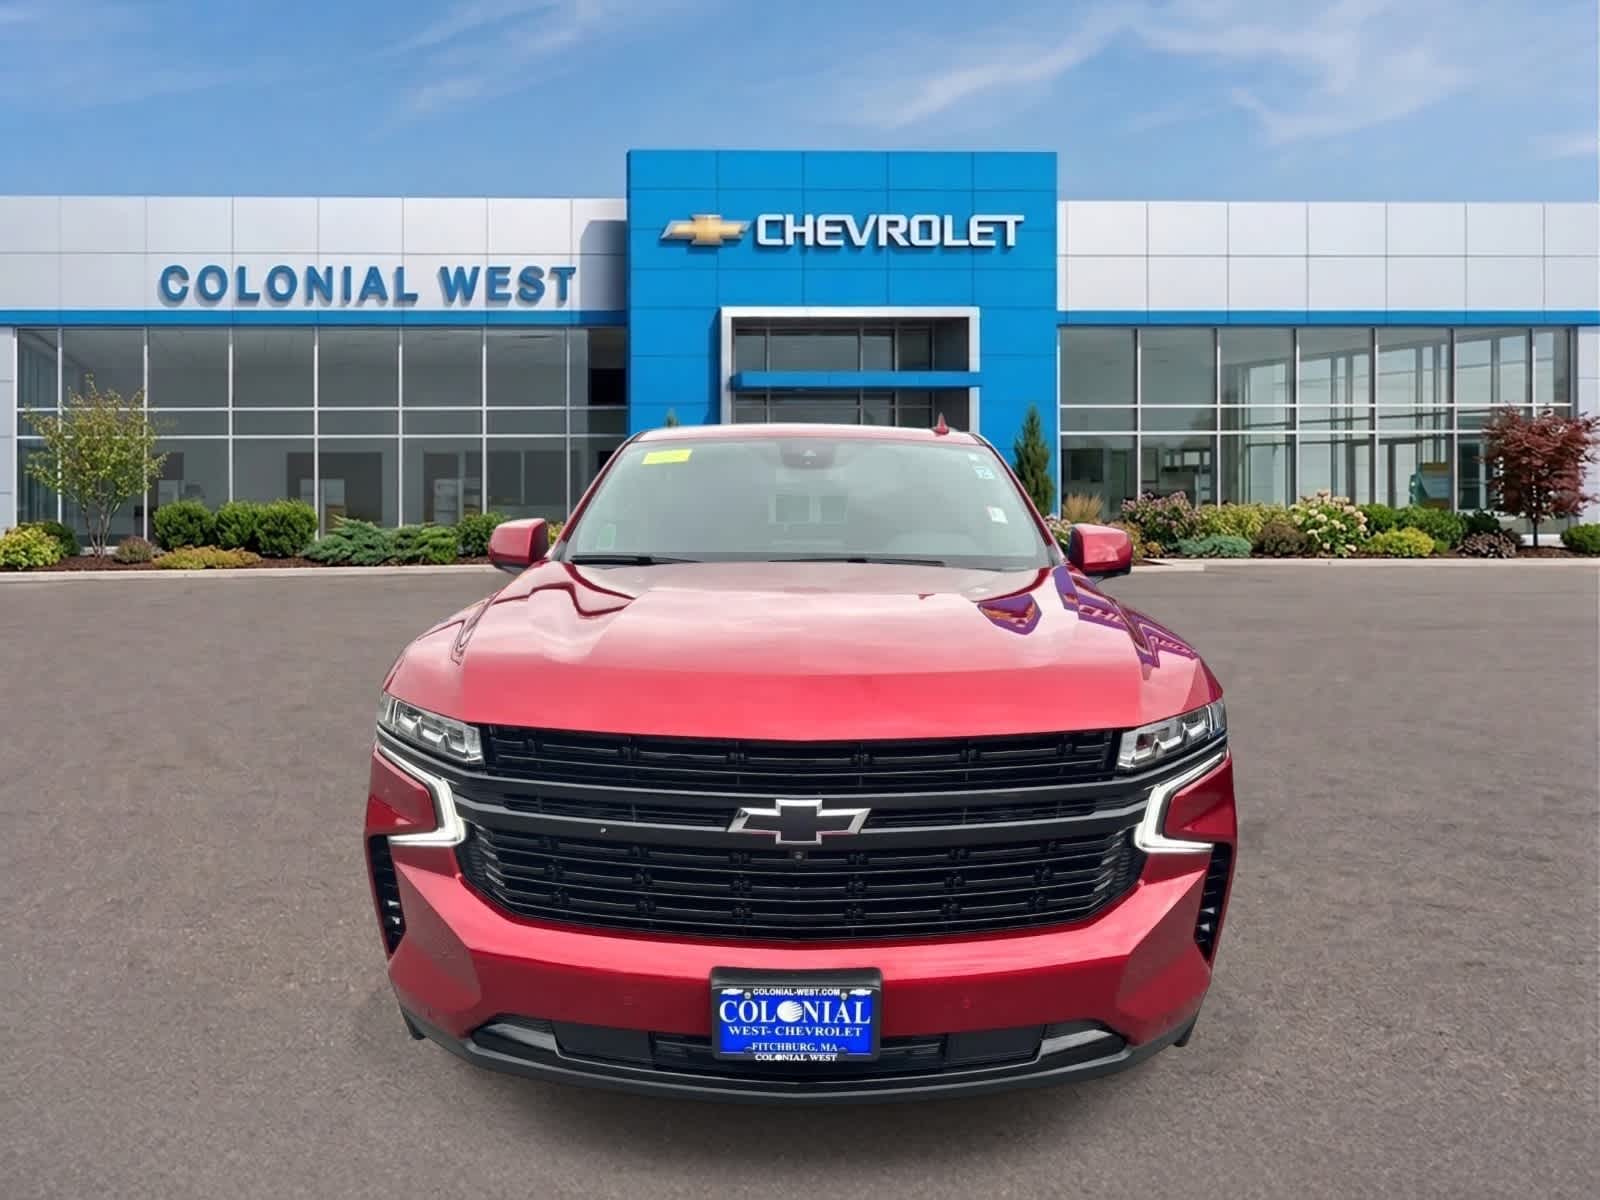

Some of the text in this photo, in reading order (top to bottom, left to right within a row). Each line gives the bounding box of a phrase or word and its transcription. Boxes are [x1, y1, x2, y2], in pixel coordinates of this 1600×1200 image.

[756, 213, 1025, 247] CHEVROLET
[159, 264, 577, 305] COLONIAL WEST
[752, 988, 841, 996] COLONIAL-WEST.COM
[719, 1000, 871, 1024] COLONIAL
[775, 1026, 863, 1037] CHEVROLET
[752, 1042, 838, 1052] FITCHBURG, MA
